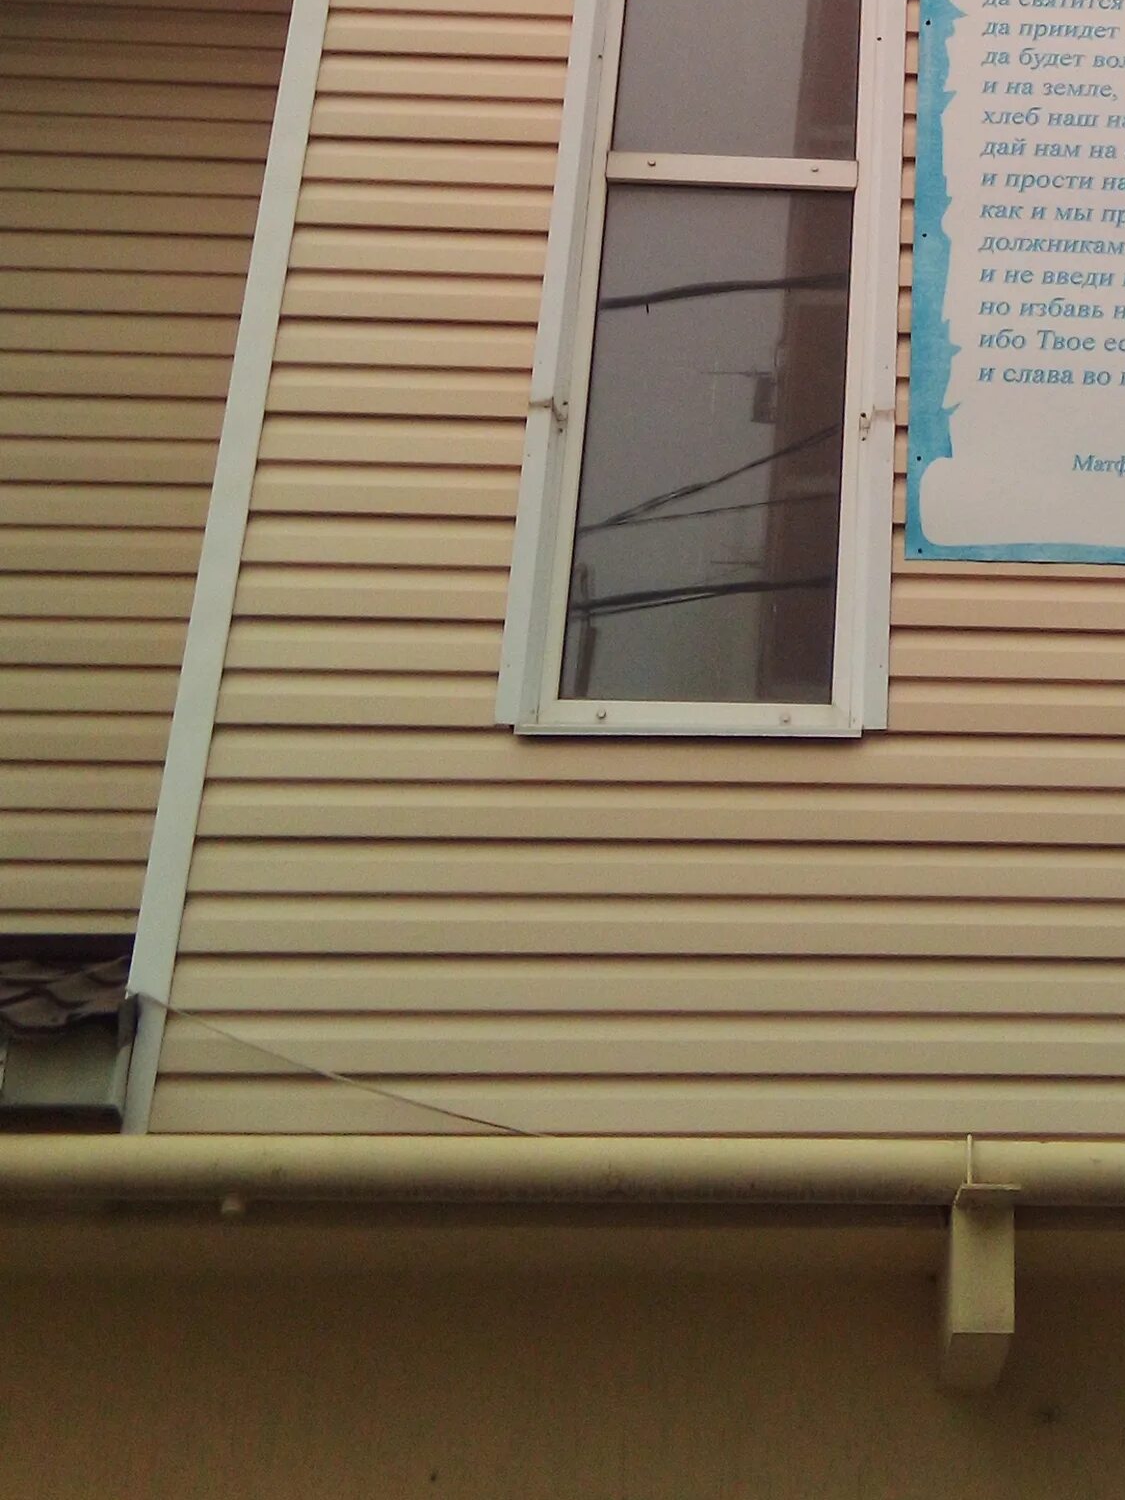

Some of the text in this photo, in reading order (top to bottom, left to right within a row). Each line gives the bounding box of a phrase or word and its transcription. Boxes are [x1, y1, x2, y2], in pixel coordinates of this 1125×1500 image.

[981, 21, 1011, 38] да
[1018, 23, 1120, 42] приидет
[980, 51, 1011, 67] да
[1018, 46, 1085, 71] будет
[981, 80, 999, 95] и
[1005, 81, 1034, 96] на
[1042, 82, 1118, 102] земле,
[981, 106, 1042, 126] хлеб
[1047, 112, 1100, 128] наш
[979, 137, 1028, 159] дай
[1033, 142, 1082, 159] нам
[1088, 144, 1117, 160] на
[980, 172, 998, 187] и
[1004, 173, 1095, 194] прости
[979, 203, 1025, 220] как
[1030, 205, 1048, 221] и
[1054, 206, 1094, 222] мы
[979, 268, 997, 283] и
[1003, 269, 1035, 285] не
[1041, 270, 1116, 289] введи
[978, 300, 1012, 317] но
[1019, 296, 1105, 319] избавь
[978, 328, 1027, 350] ибо
[1036, 329, 1097, 352] Твое
[977, 366, 997, 383] и
[1002, 367, 1075, 385] слава
[1081, 370, 1113, 387] во
